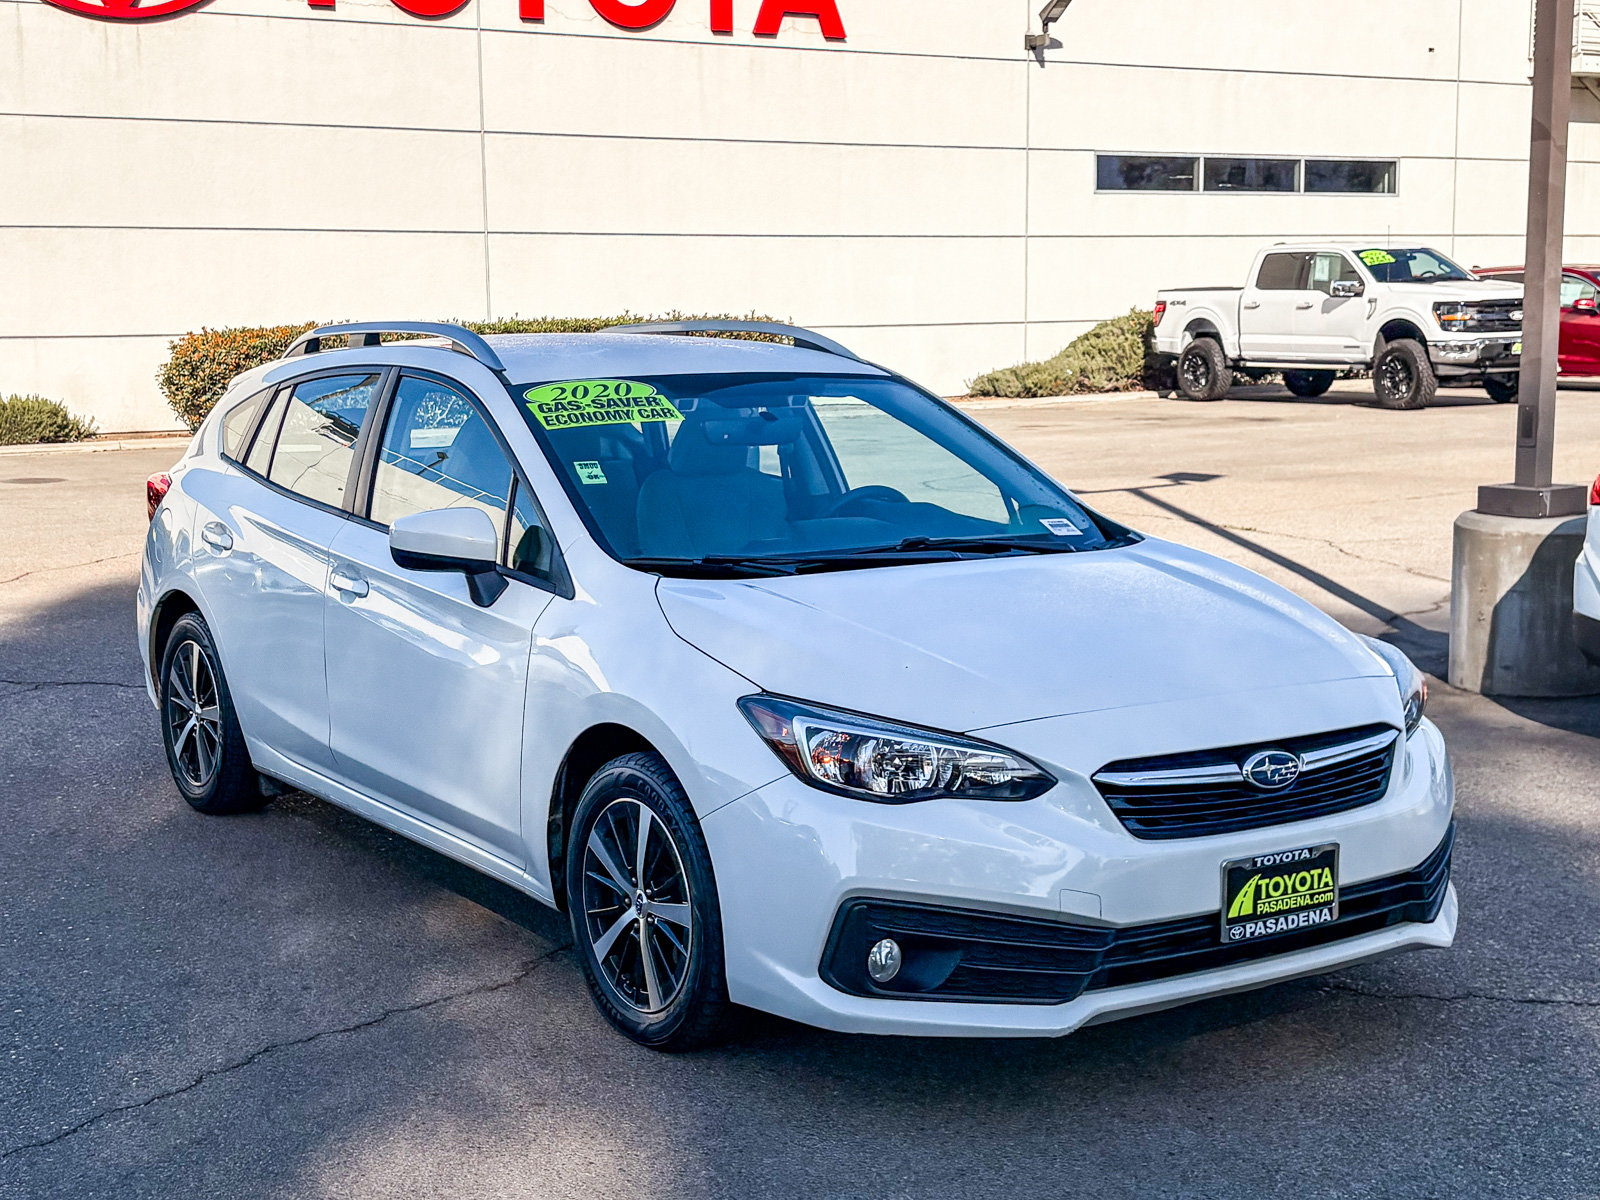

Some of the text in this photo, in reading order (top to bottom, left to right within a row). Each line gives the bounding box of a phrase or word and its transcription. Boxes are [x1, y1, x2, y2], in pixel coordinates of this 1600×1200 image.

[550, 382, 632, 401] 2020
[537, 396, 663, 414] GAS-SAVER
[543, 407, 676, 427] ECONOMY CAR
[1254, 849, 1311, 867] TOYOTA
[1257, 867, 1334, 899] TOYOTA
[1256, 891, 1334, 916] PASADENA.com
[1245, 908, 1332, 938] PASADENA
